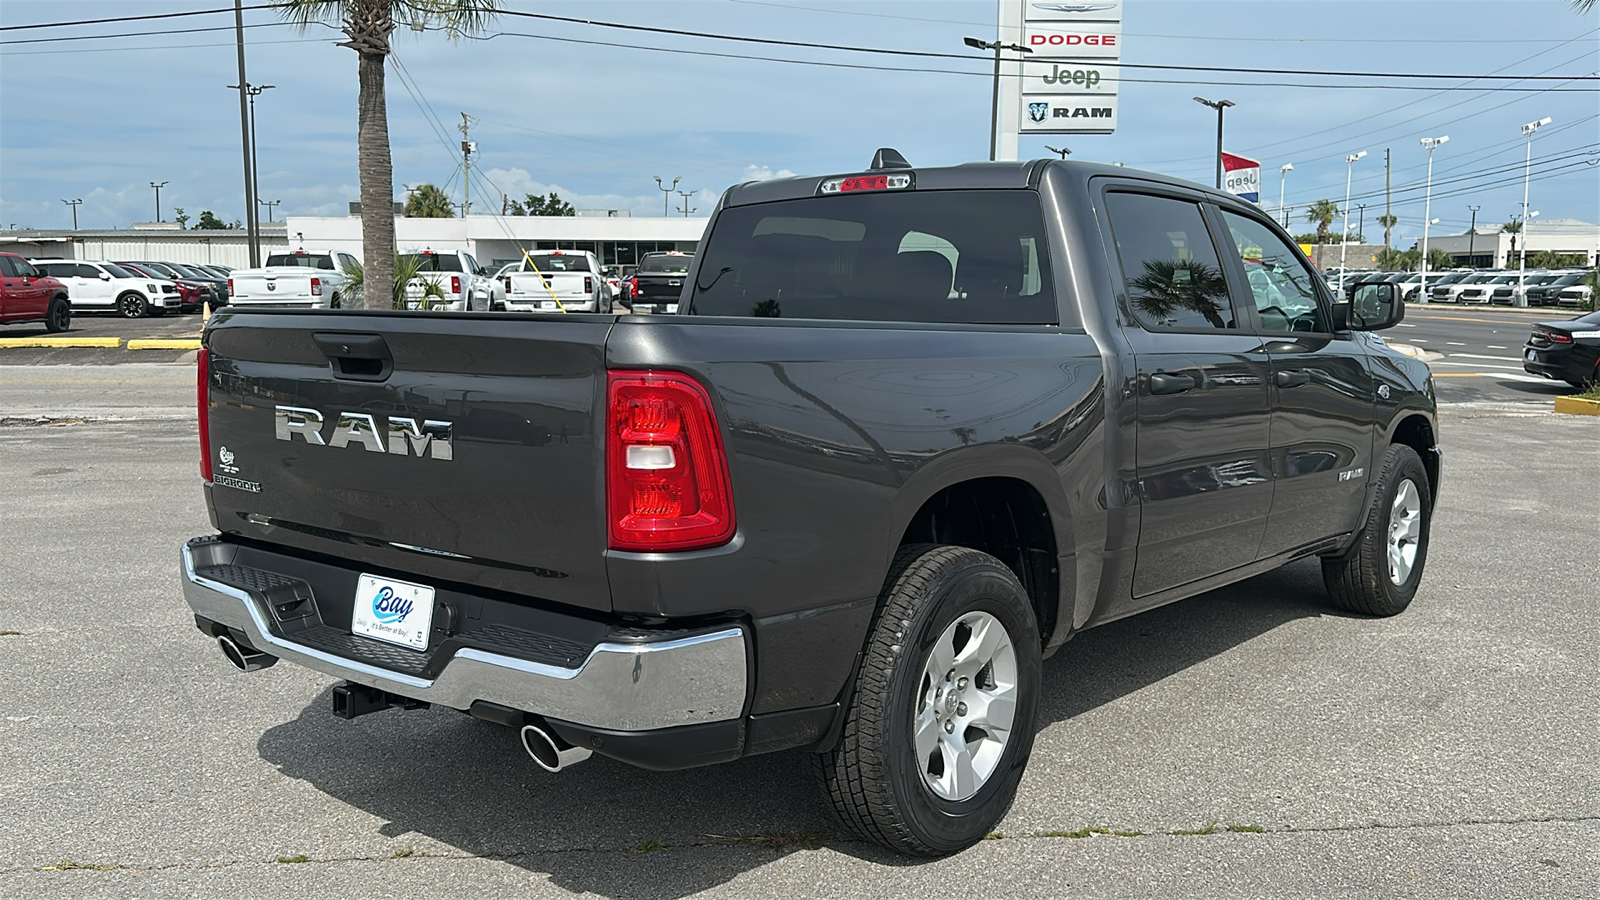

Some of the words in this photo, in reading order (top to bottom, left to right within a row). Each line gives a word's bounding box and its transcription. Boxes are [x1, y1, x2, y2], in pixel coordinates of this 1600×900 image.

[1030, 34, 1116, 46] DODGE
[1042, 65, 1100, 89] Jeep
[1052, 107, 1112, 118] RAM
[275, 405, 453, 461] RAM
[375, 586, 414, 623] Bay
[379, 623, 393, 633] Better
